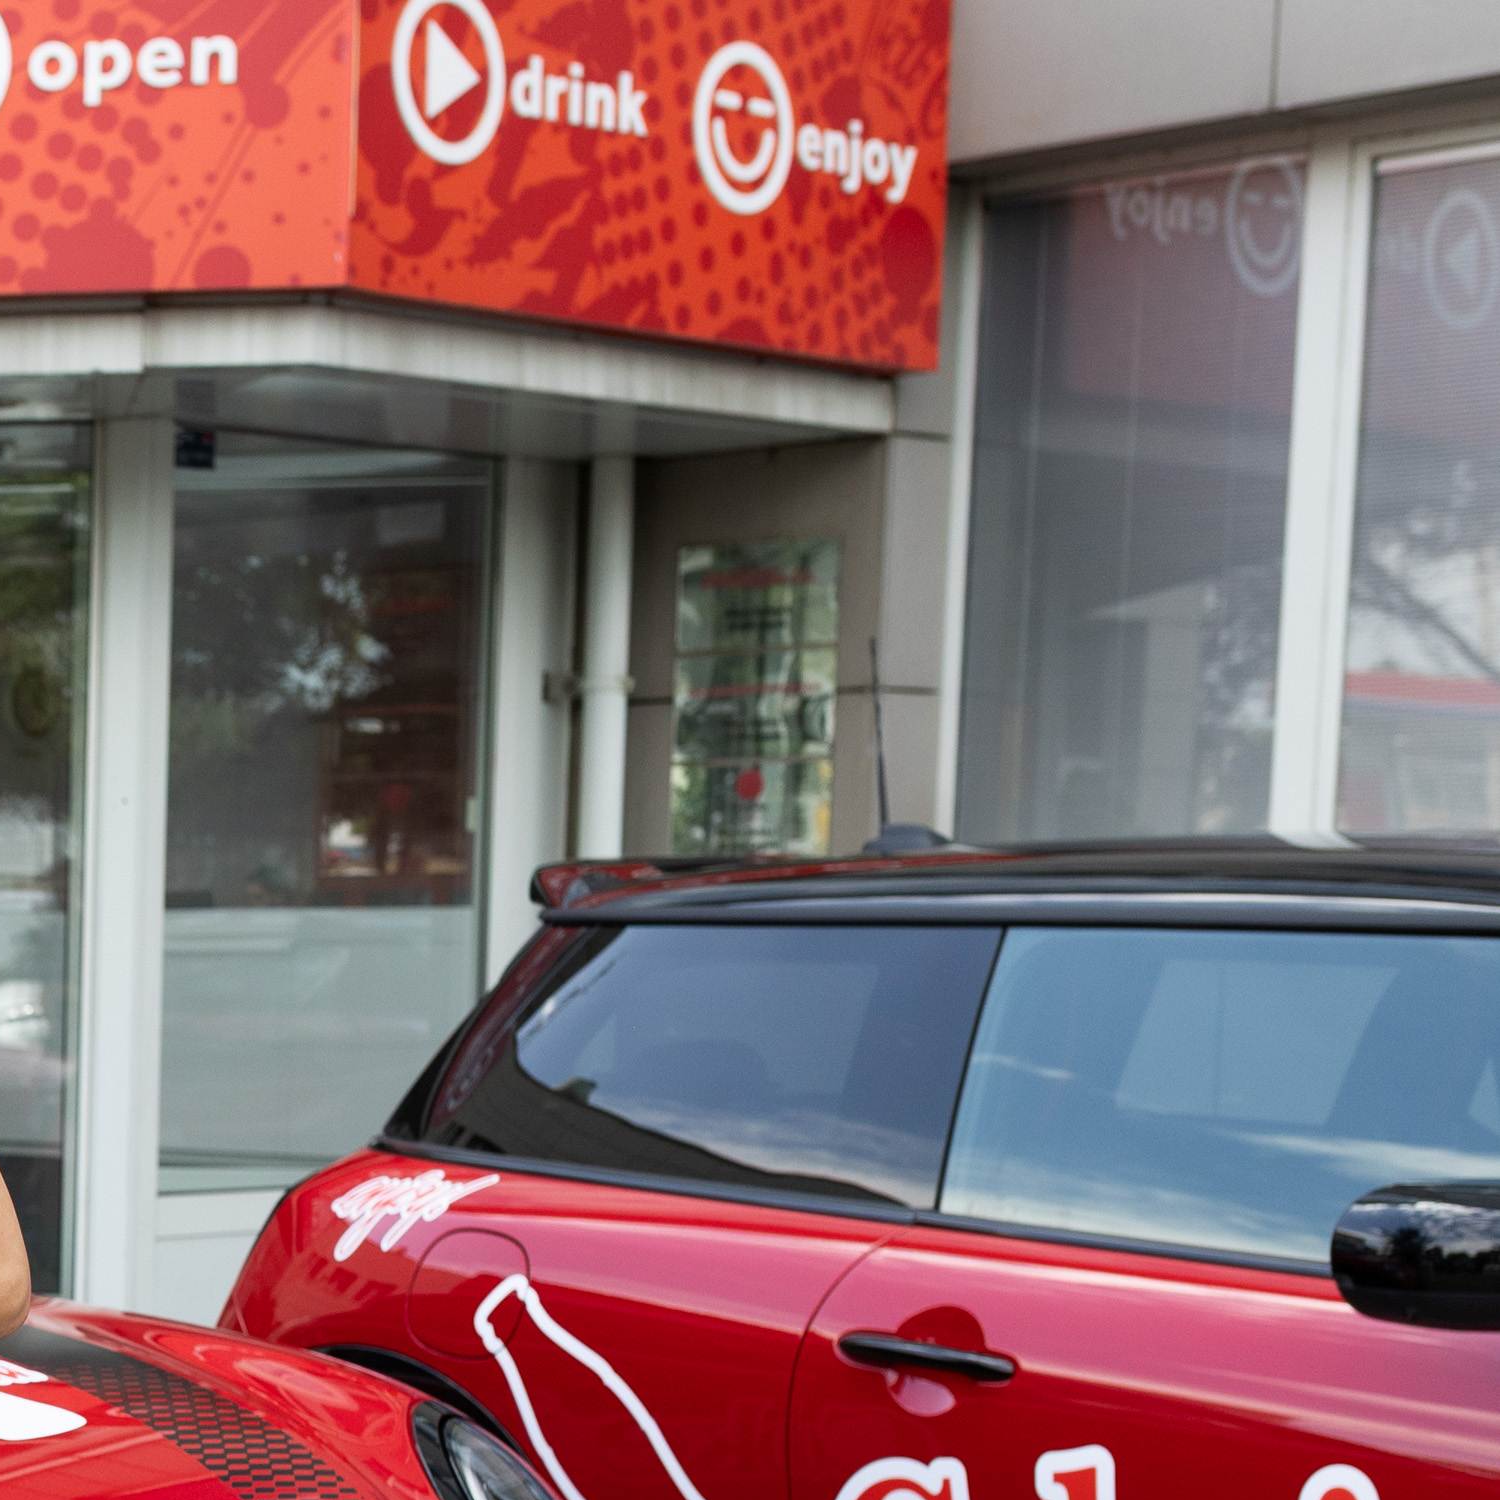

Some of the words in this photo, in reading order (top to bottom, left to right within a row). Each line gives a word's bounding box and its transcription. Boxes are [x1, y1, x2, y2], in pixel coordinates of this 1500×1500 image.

[27, 33, 238, 107] open
[510, 55, 648, 137] drink
[797, 119, 918, 204] enjoy
